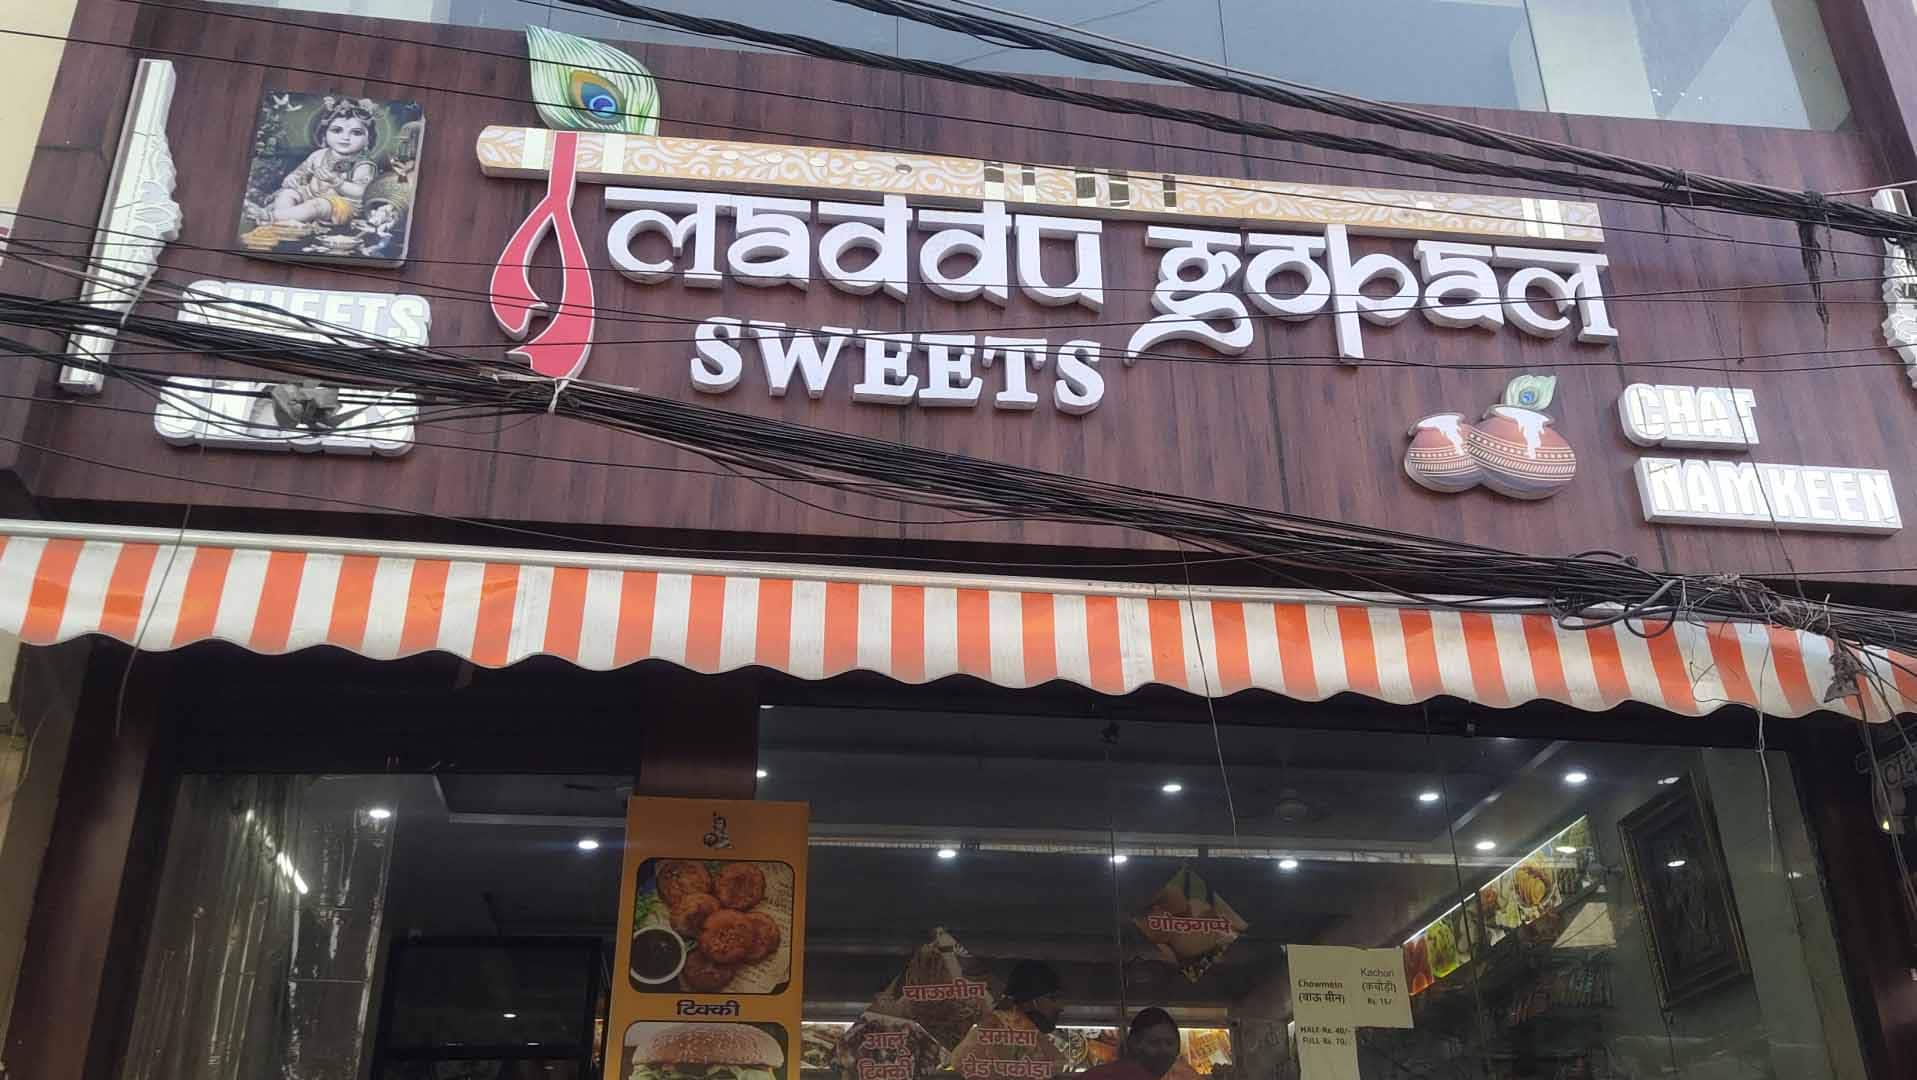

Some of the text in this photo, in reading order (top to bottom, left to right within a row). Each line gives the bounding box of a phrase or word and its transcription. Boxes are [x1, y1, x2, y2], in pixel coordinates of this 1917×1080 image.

[690, 316, 1105, 415] SWEETS
[1618, 383, 1760, 448] CHAT
[1634, 457, 1902, 533] NAMKEEN
[676, 999, 740, 1017] टिक्की
